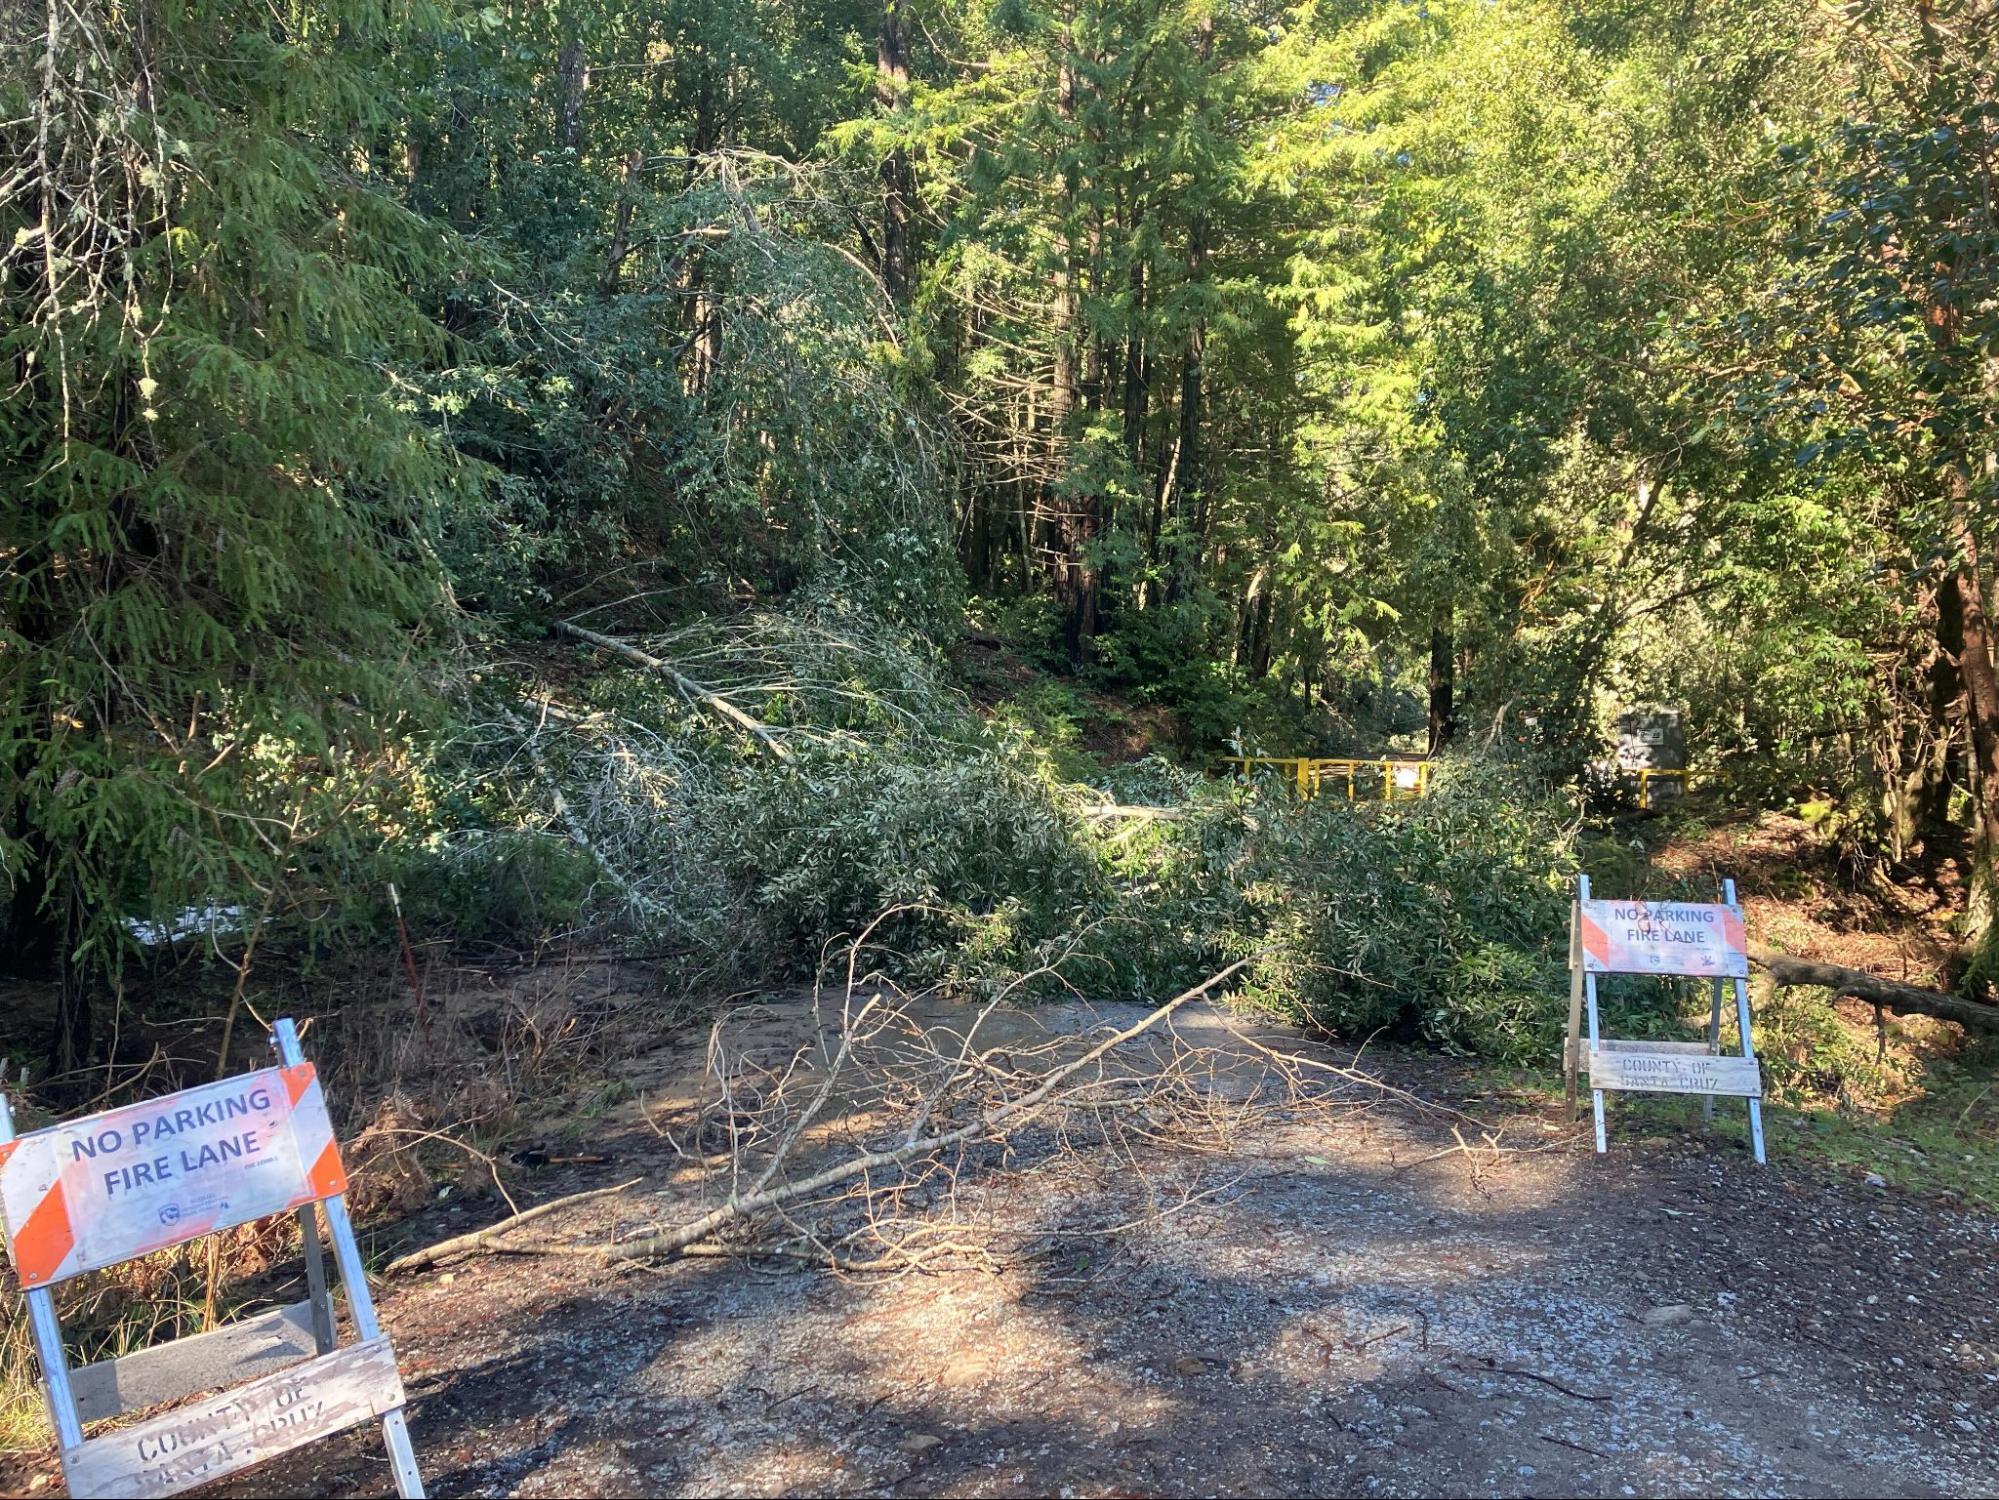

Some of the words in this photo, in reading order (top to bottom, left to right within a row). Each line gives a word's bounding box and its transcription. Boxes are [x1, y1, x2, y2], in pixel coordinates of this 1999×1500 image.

[1615, 908, 1639, 920] NO
[1644, 908, 1714, 923] PARKING
[1627, 929, 1660, 941] FIRE
[1664, 930, 1705, 943] LANE
[1623, 1059, 1680, 1073] COUNTY
[1692, 1062, 1711, 1074] OF
[1680, 1077, 1718, 1090] CRUZ
[71, 1130, 122, 1162] NO
[132, 1088, 271, 1145] PARKING
[103, 1156, 172, 1195] FIRE
[180, 1131, 261, 1172] LANE
[135, 1441, 233, 1485] ATA
